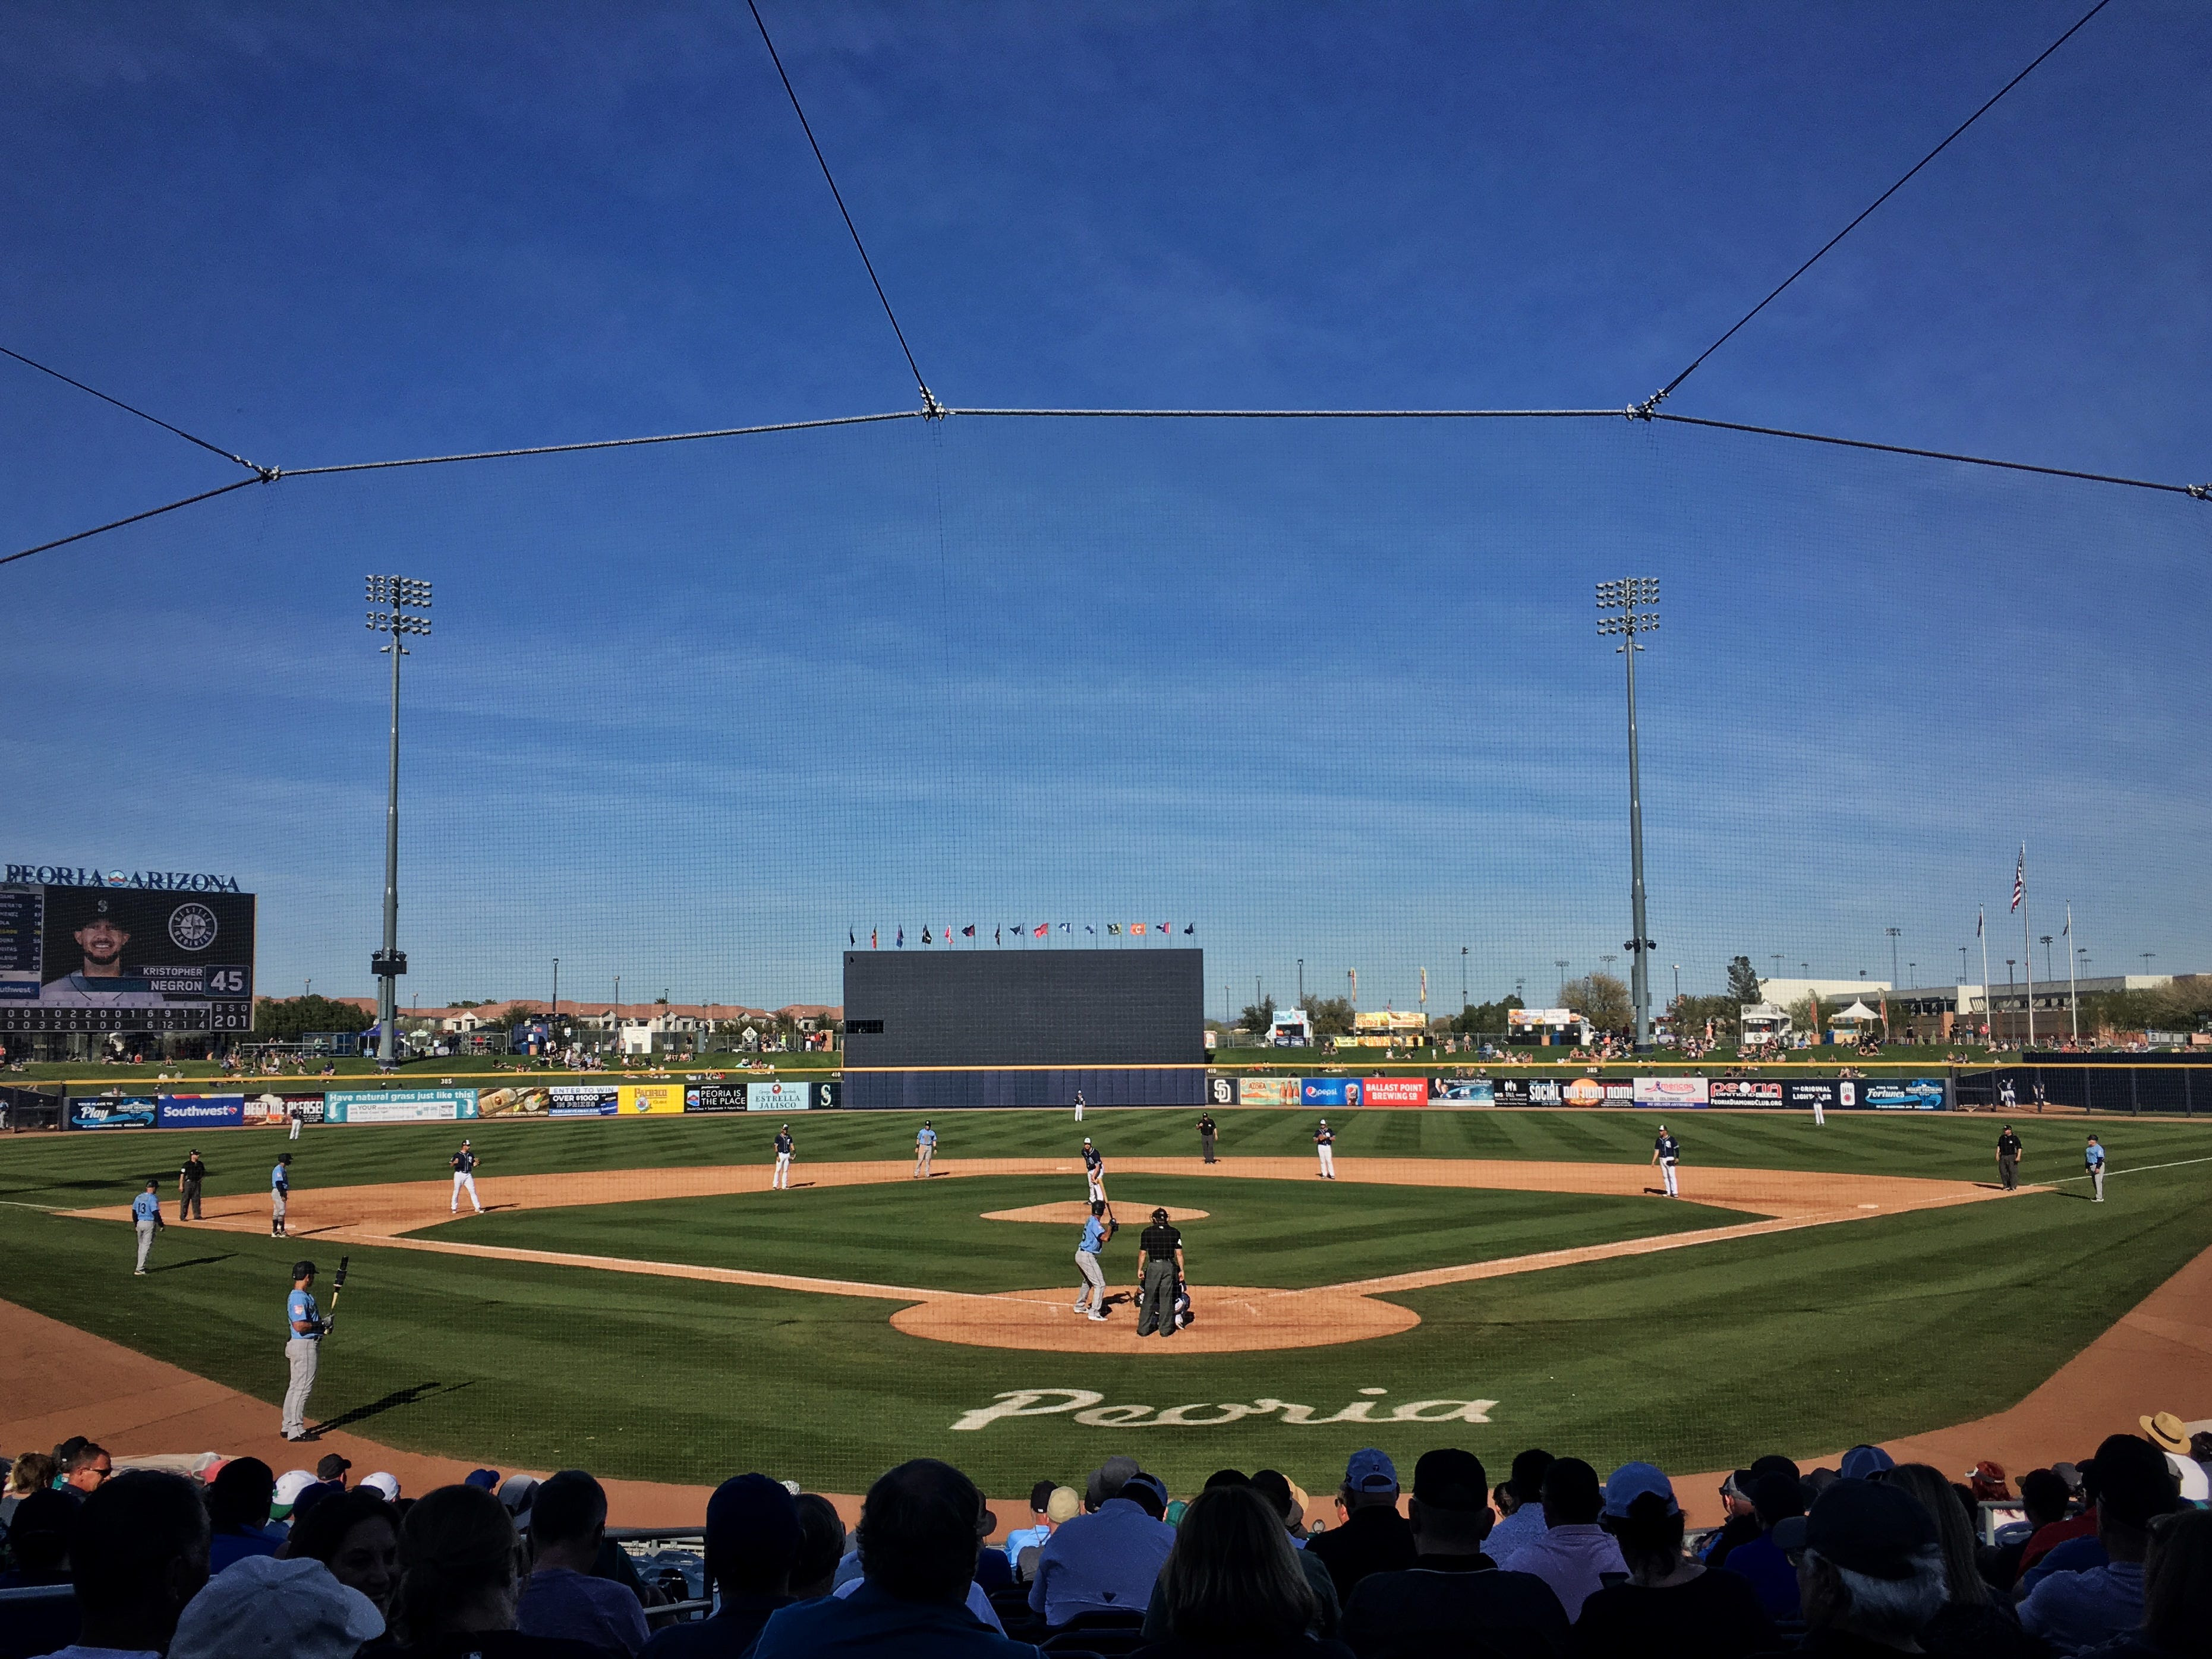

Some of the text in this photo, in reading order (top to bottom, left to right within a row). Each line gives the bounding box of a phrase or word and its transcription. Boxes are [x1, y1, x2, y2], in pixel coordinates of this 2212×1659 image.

[5, 864, 241, 893] PEORIA ARIZONA
[143, 967, 203, 977] KRISTOPHER
[150, 980, 202, 991] NEGRON
[210, 970, 243, 992] 45
[215, 1015, 247, 1027] 2 0 1
[1318, 1088, 1337, 1096] pepsi
[1530, 1080, 1561, 1100] SOCIAL
[1867, 1088, 1905, 1098] Fortunes
[356, 1092, 388, 1100] natural
[391, 1092, 415, 1102] grass
[417, 1092, 433, 1100] just
[81, 1106, 109, 1121] Play
[163, 1106, 228, 1117] Southwest
[244, 1102, 267, 1115] BEER
[138, 1203, 146, 1214] 13
[949, 1387, 1499, 1430] Peoria
